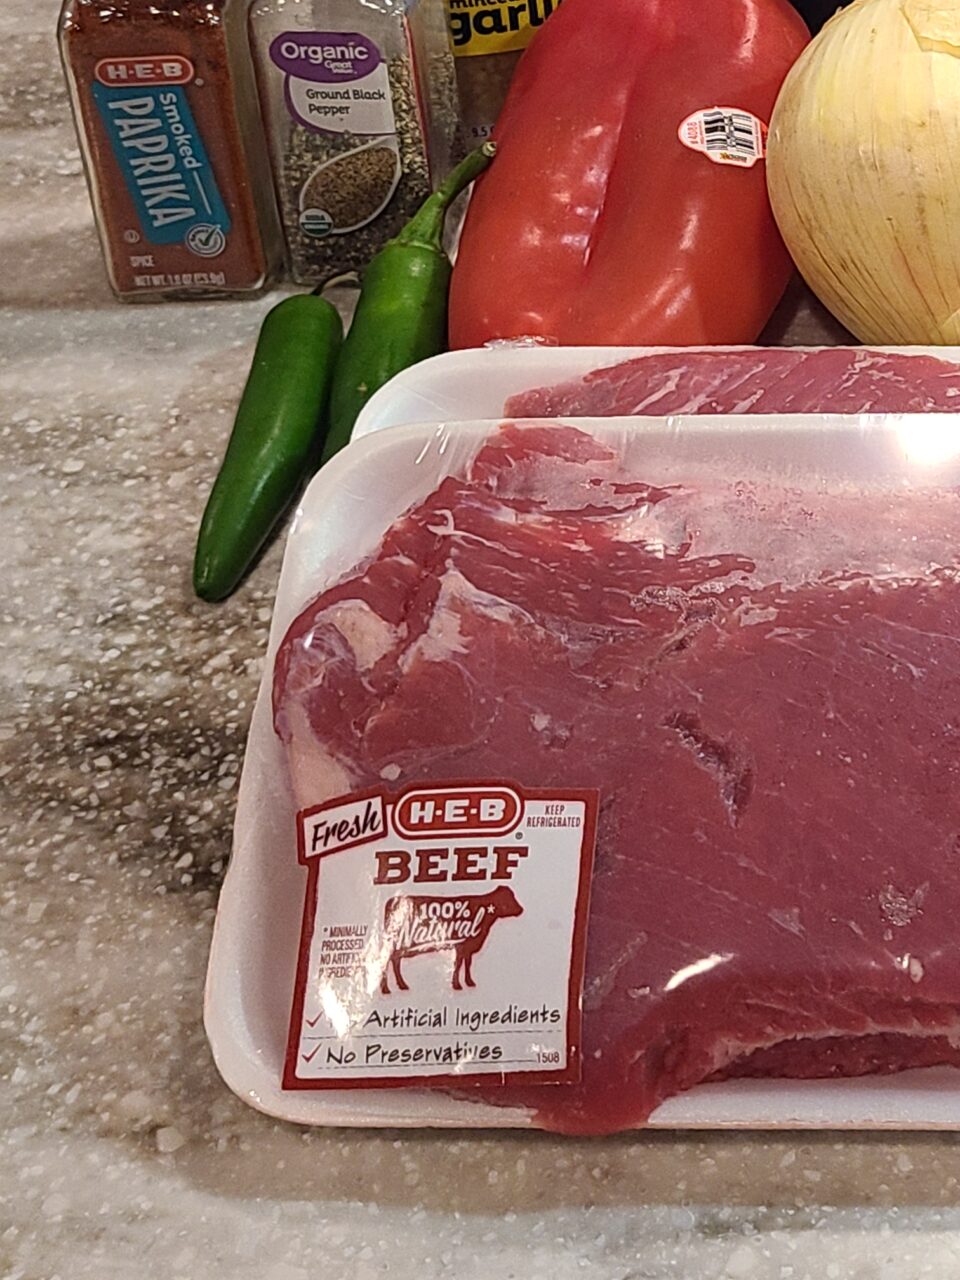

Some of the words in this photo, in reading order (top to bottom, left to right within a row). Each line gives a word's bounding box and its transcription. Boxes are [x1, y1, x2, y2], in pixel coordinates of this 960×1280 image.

[281, 42, 369, 64] Organic
[306, 88, 351, 100] Ground
[353, 88, 387, 100] Black
[308, 103, 351, 117] Pepper
[159, 92, 203, 169] Smoked
[107, 96, 197, 228] PAPRIKA
[545, 804, 565, 815] KEEP
[311, 800, 381, 852] Fresh
[526, 816, 581, 828] REFRIGERATED
[373, 846, 529, 885] BEEF
[418, 900, 471, 919] 100%
[329, 925, 368, 938] MINIMALLY
[320, 953, 331, 966] NO
[363, 1006, 448, 1029] Artificial
[456, 1005, 561, 1032] Ingredients
[326, 1045, 356, 1064] No
[365, 1043, 503, 1064] Preservatives
[536, 1052, 560, 1063] 1508
